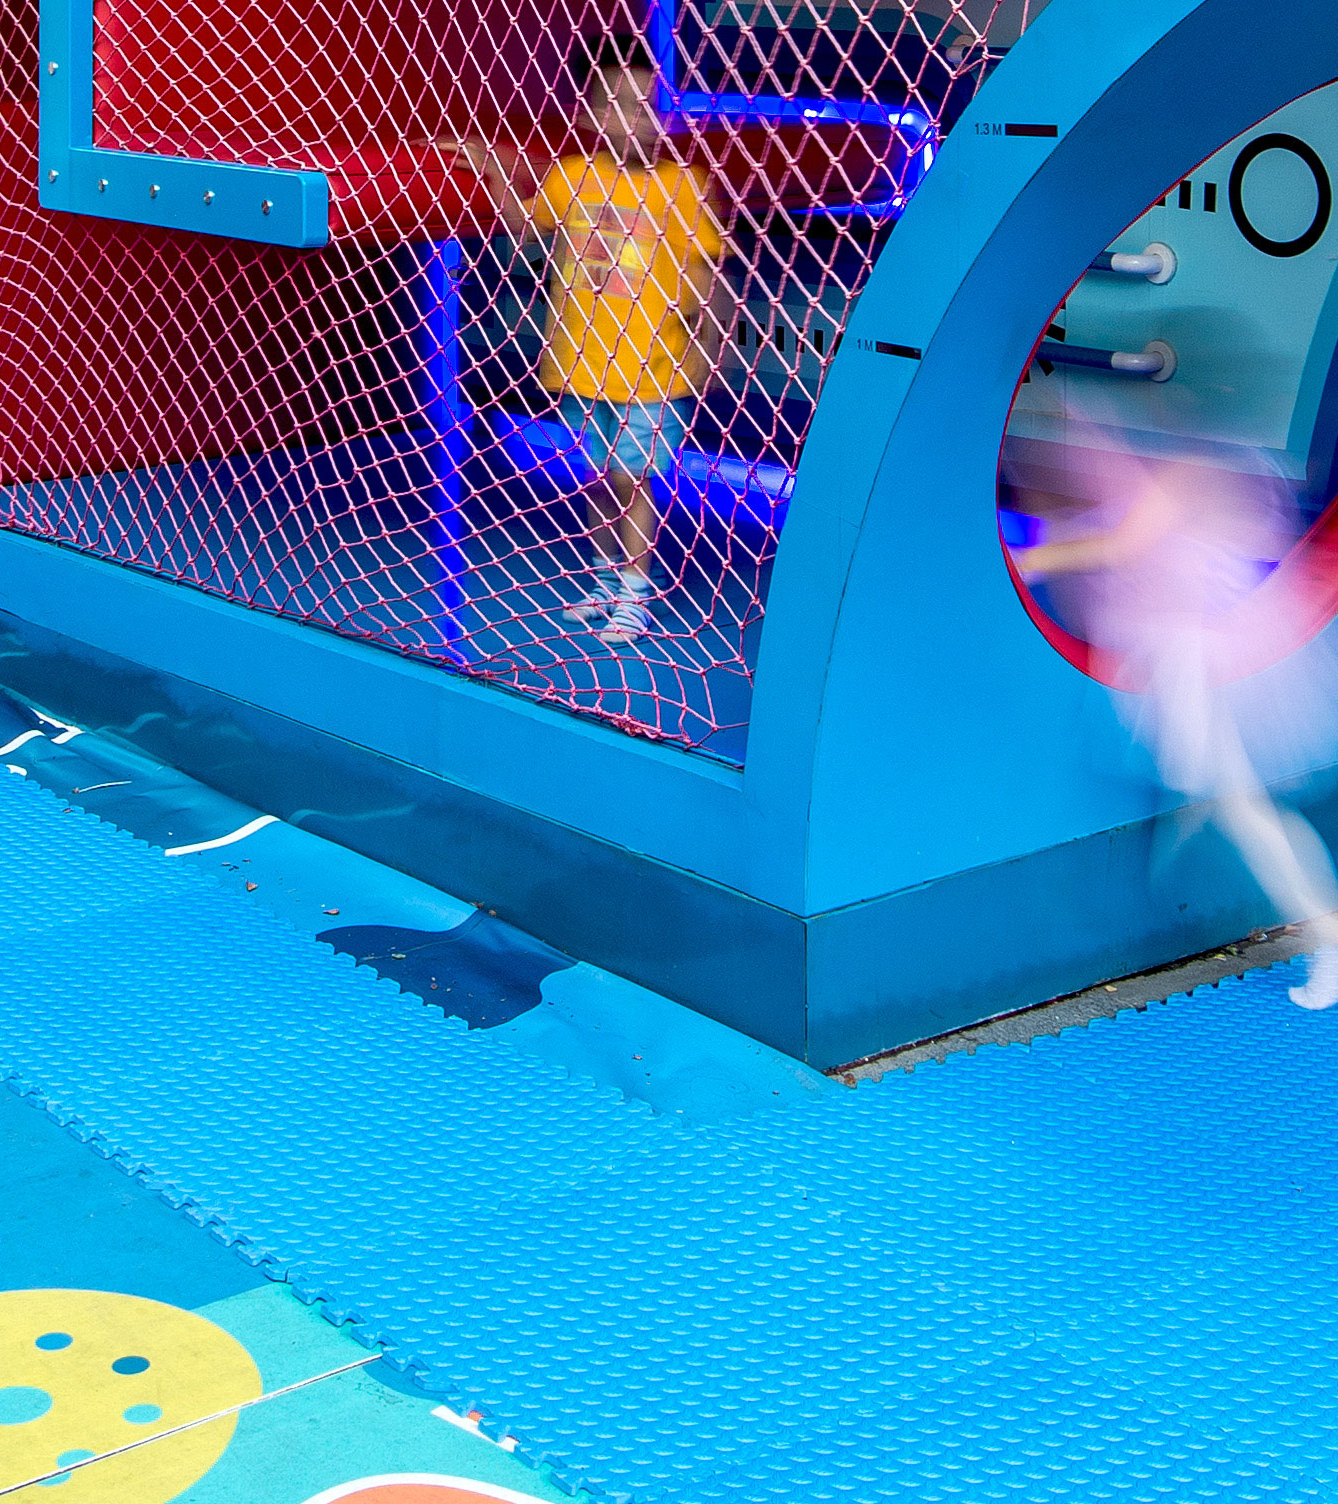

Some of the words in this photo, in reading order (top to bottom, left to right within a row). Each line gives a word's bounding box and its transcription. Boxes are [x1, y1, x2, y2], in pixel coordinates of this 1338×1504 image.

[974, 123, 990, 135] 1.3
[992, 123, 1002, 135] M
[864, 339, 873, 352] M
